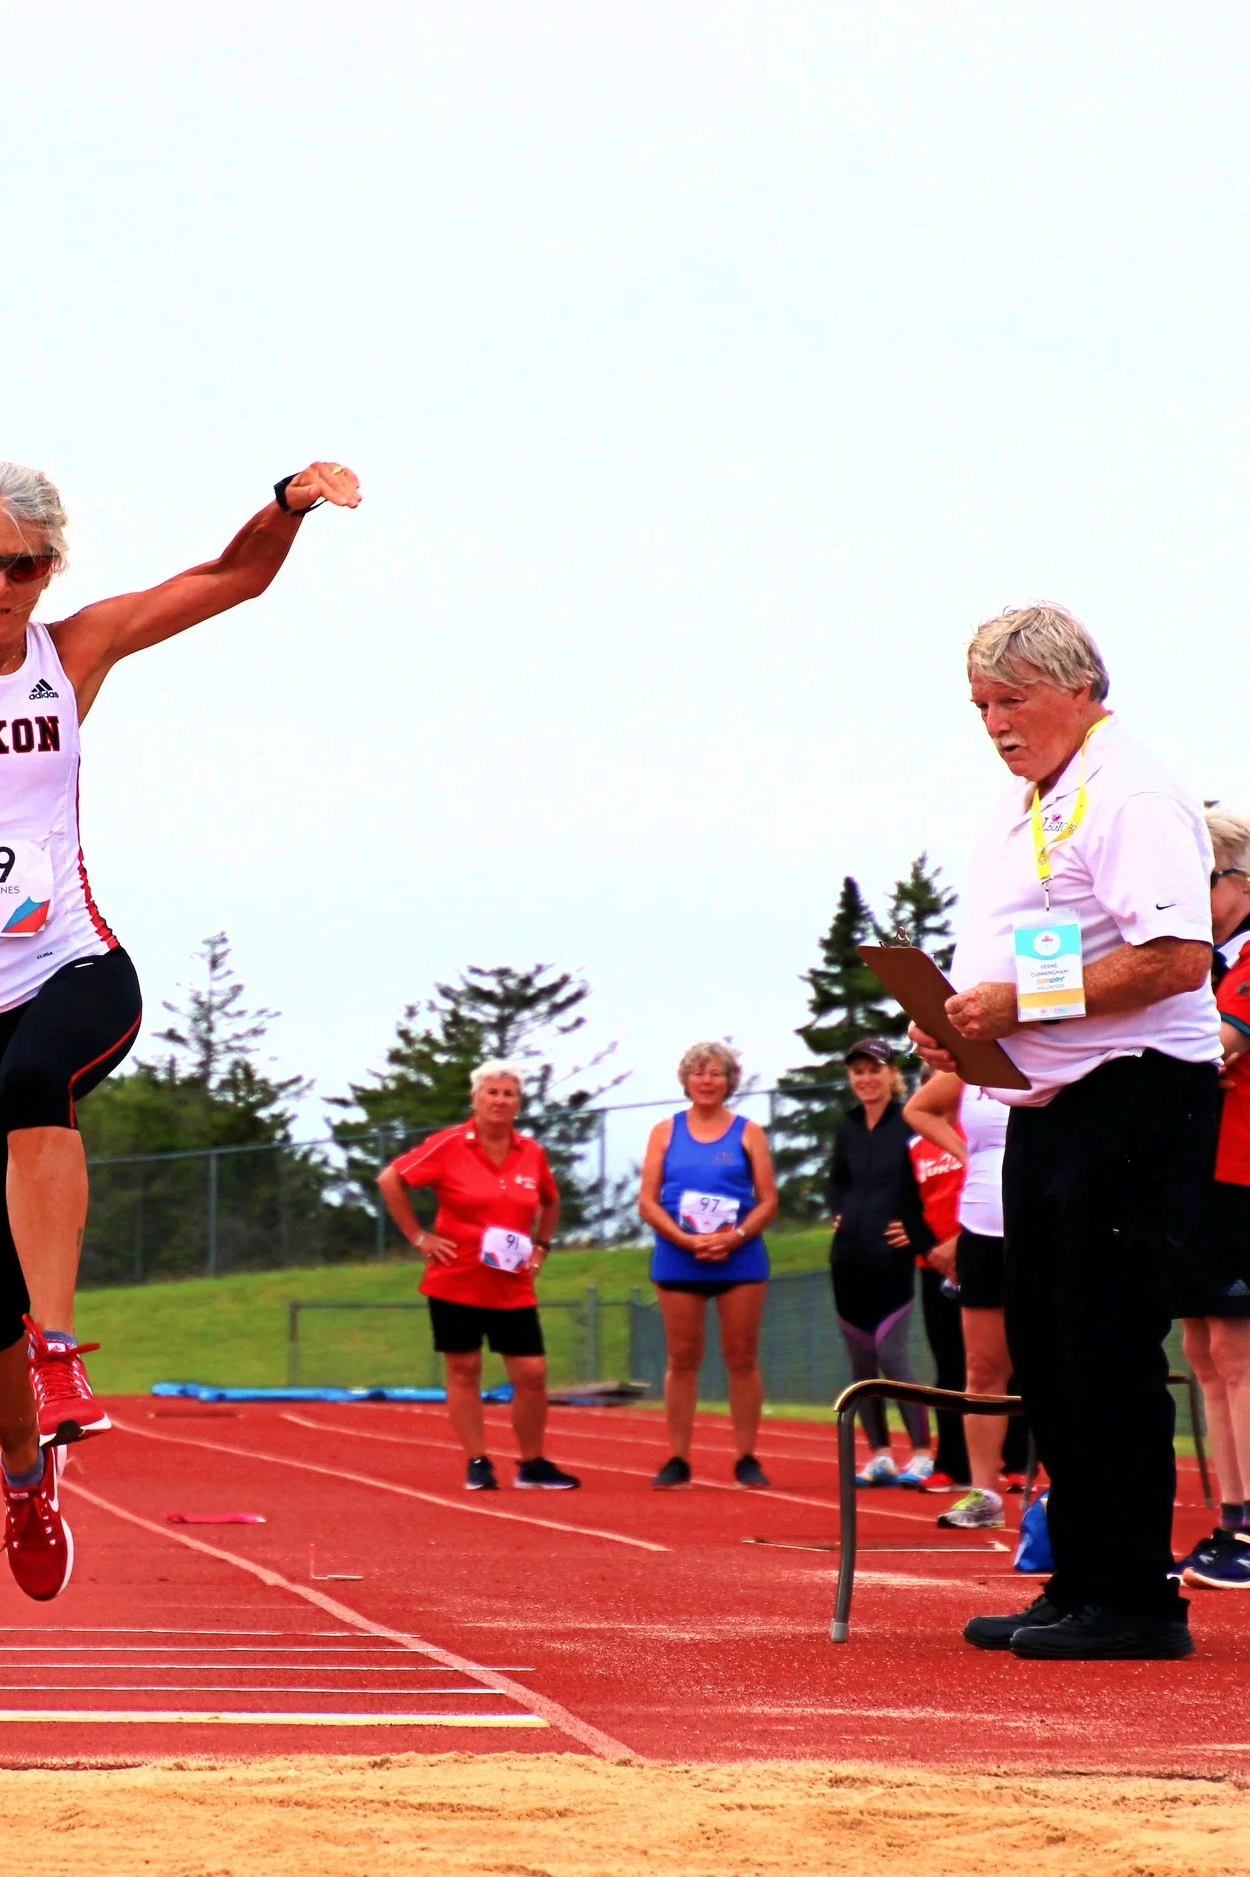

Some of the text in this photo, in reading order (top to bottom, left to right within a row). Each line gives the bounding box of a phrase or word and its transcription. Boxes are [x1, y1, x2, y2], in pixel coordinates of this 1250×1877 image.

[29, 691, 59, 700] adidas
[700, 1197, 721, 1213] 97
[506, 1234, 520, 1250] 91
